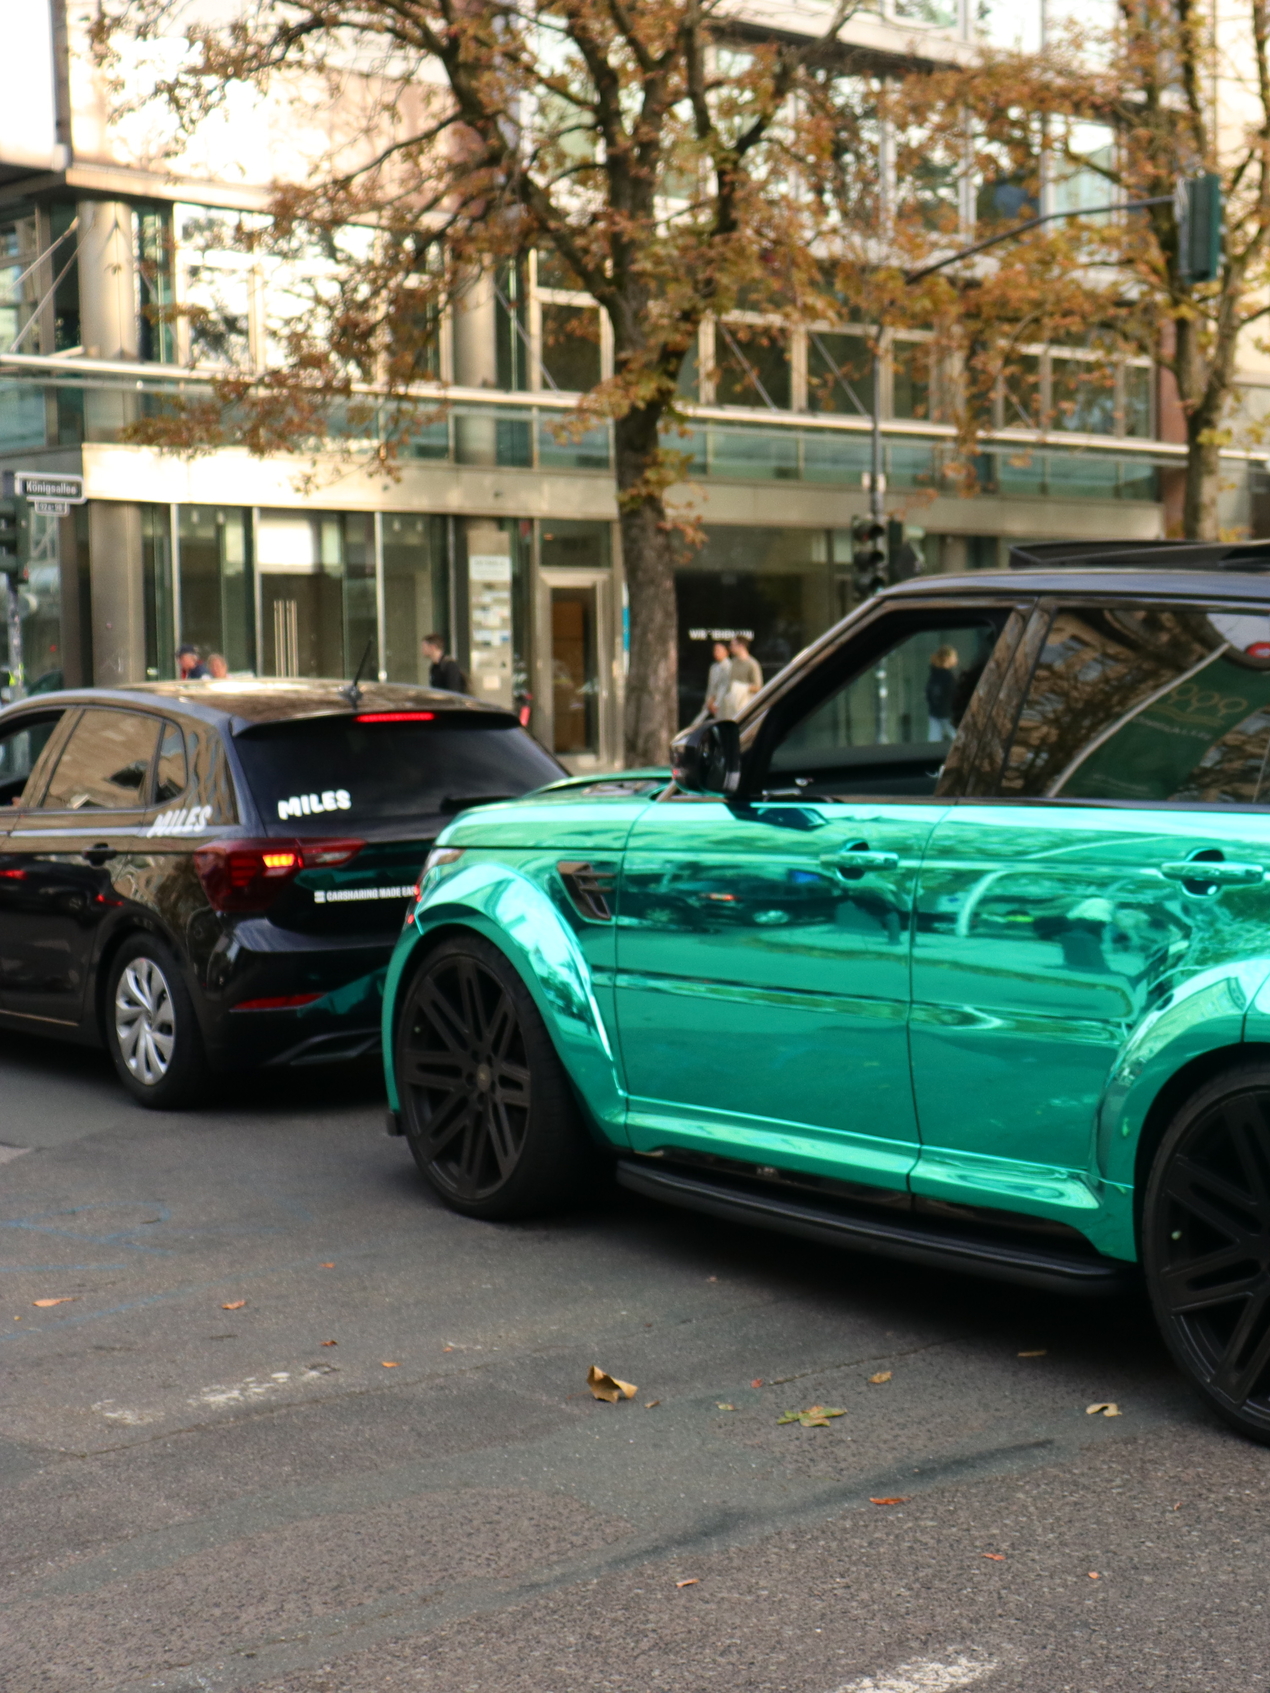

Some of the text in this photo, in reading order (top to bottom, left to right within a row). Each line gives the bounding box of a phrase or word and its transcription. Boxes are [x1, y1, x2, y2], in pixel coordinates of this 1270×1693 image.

[26, 481, 77, 495] Königsallee
[277, 788, 352, 820] MILES
[146, 804, 213, 838] MILES
[326, 885, 417, 902] CARSHARING MADE EA
